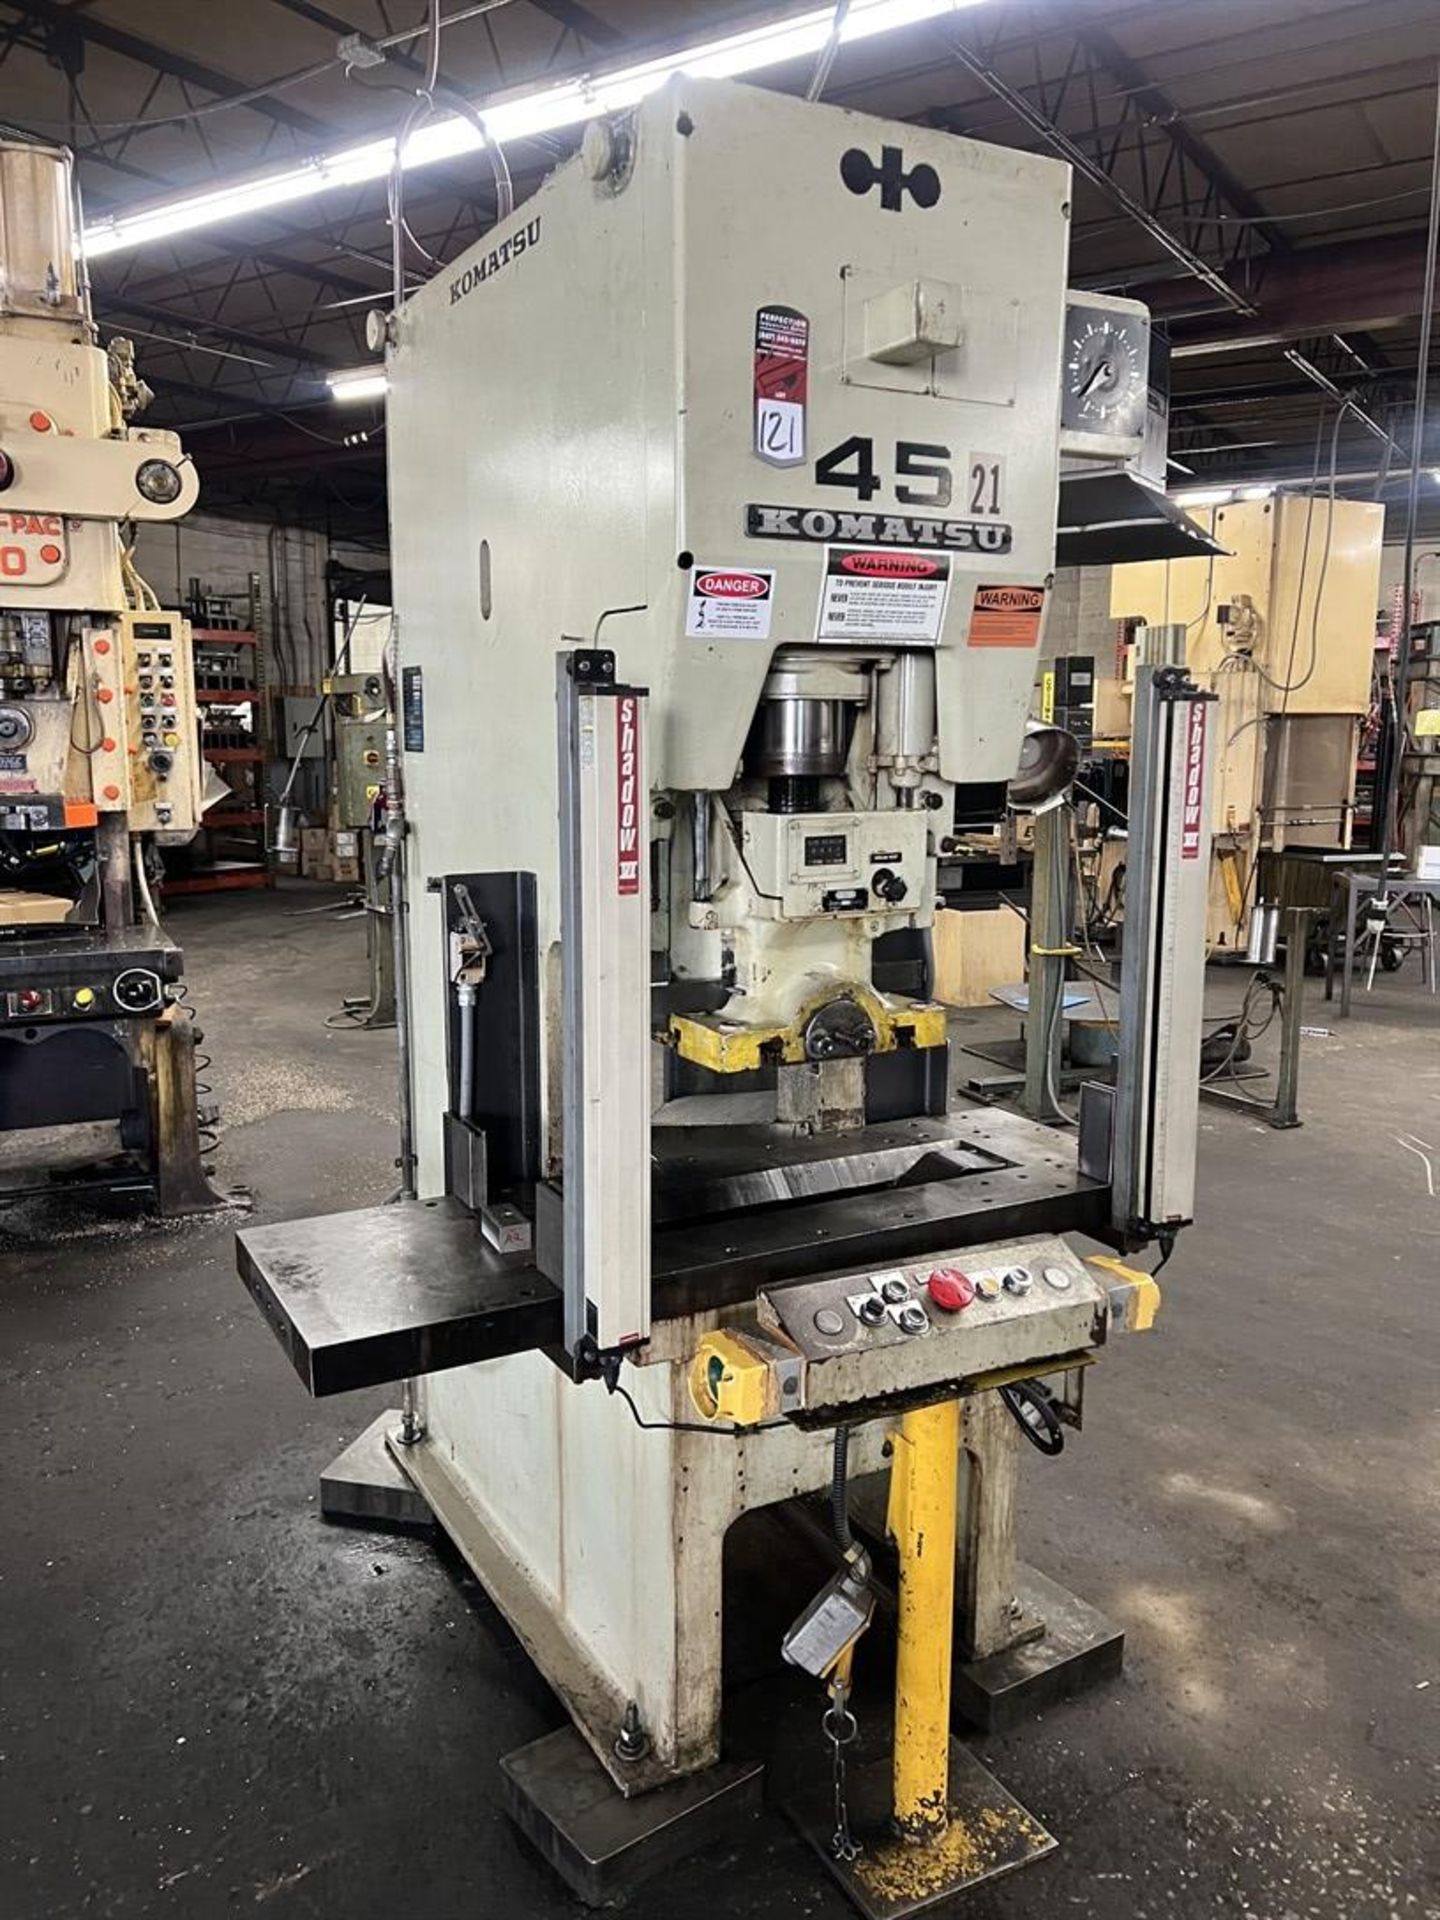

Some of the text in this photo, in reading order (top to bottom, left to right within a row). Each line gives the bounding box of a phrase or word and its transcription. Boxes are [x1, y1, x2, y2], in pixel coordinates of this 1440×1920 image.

[449, 215, 541, 306] KOMATSU
[760, 410, 795, 453] 121
[815, 436, 951, 507] 45
[970, 464, 1000, 514] 21
[757, 508, 1006, 549] KOMATSU
[705, 578, 760, 592] DANGER
[852, 557, 928, 573] WARNING
[981, 592, 1039, 606] WARNING
